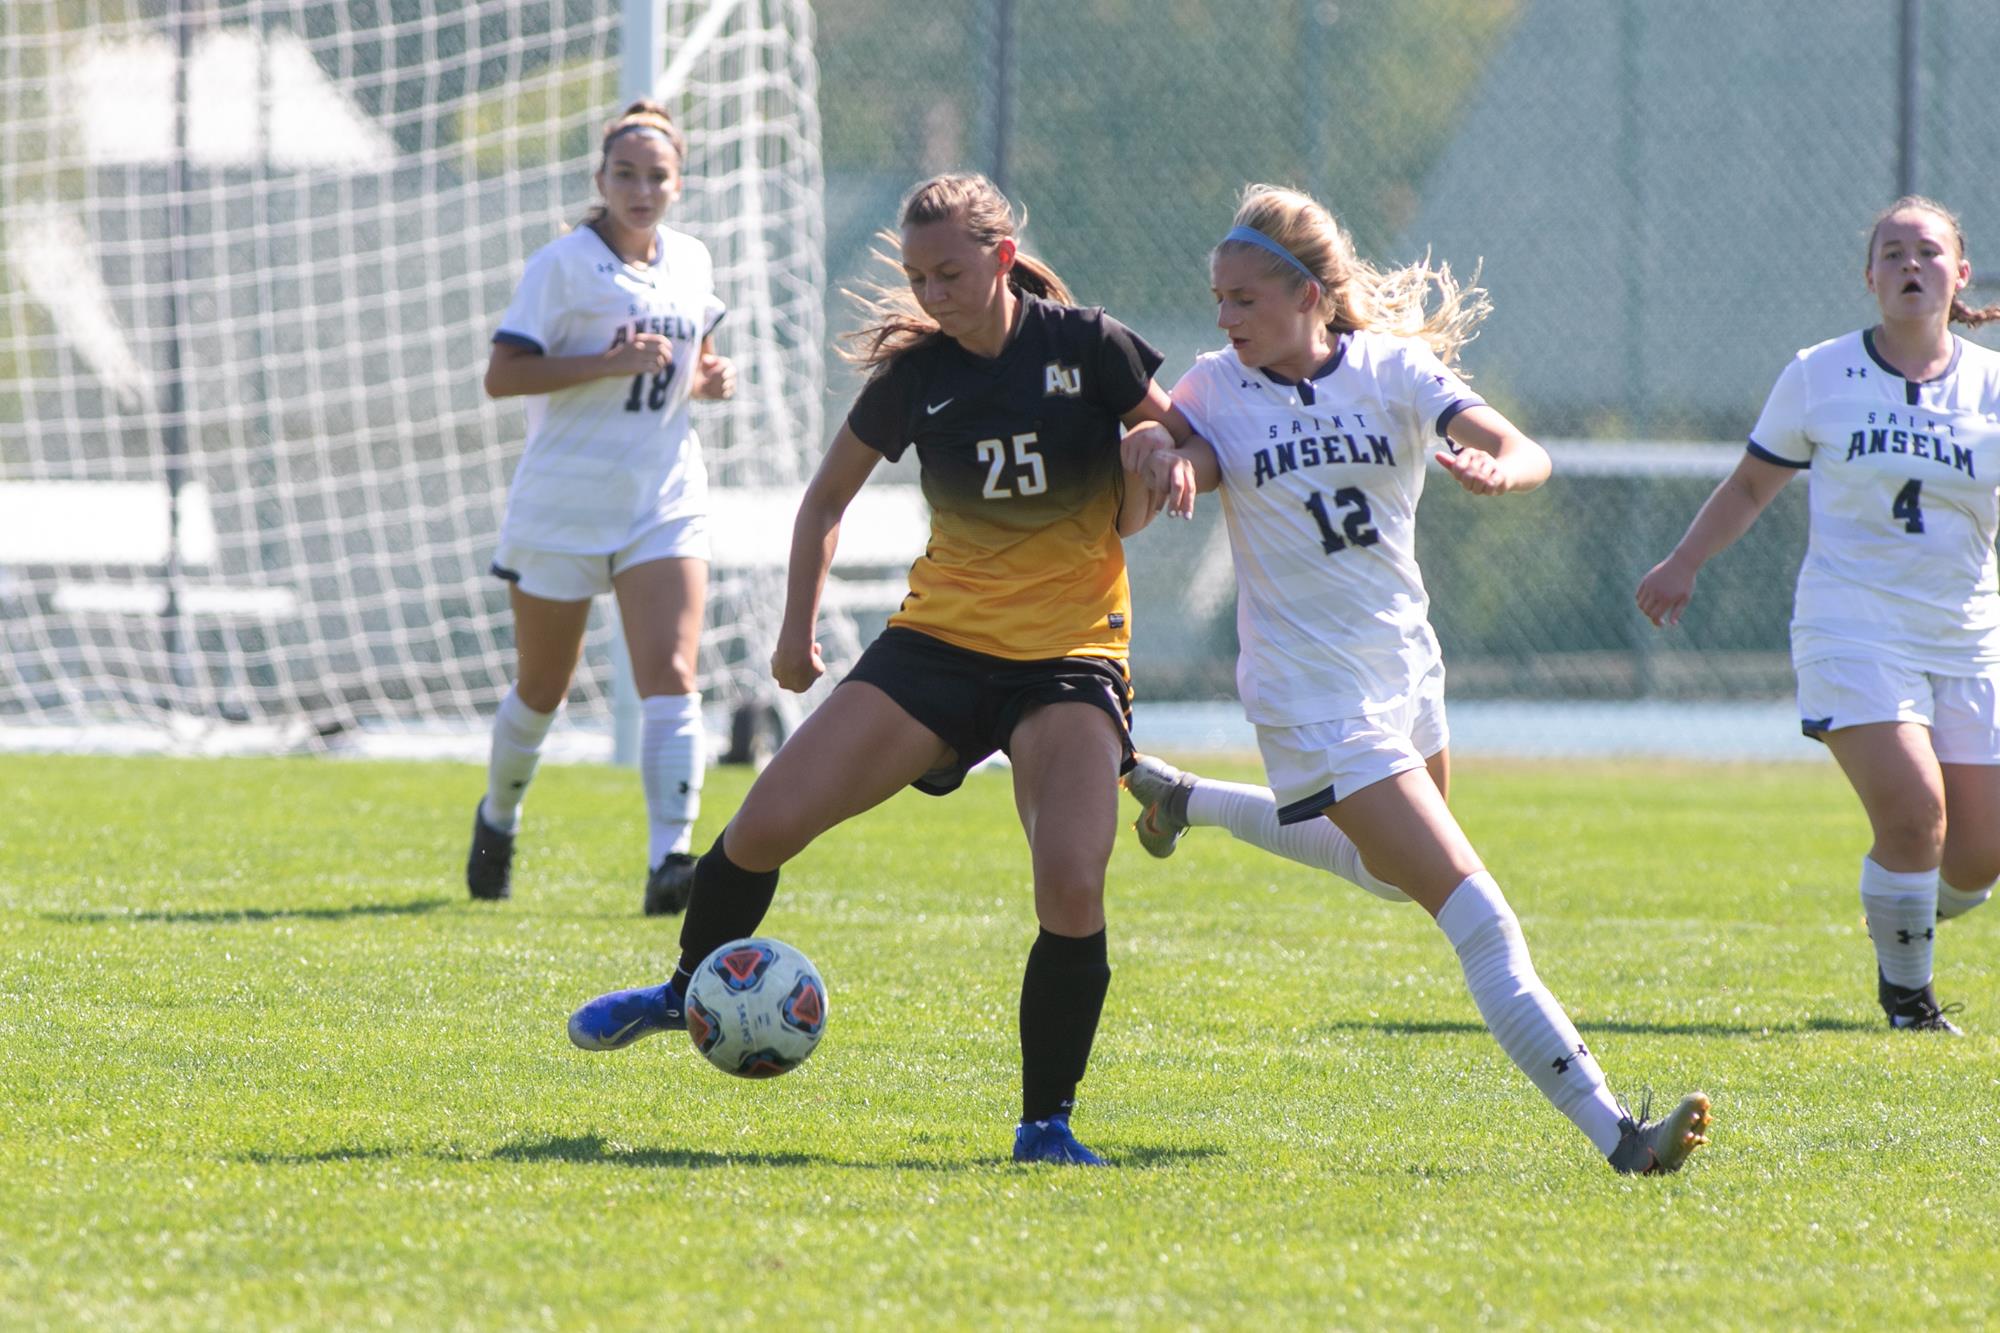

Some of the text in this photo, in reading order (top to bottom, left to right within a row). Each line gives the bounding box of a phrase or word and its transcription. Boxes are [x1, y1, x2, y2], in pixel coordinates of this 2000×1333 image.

[625, 362, 676, 412] 18
[1045, 362, 1082, 395] AU
[1268, 413, 1367, 439] SAINT
[1867, 411, 1955, 438] SAINT
[976, 432, 1047, 499] 25
[1253, 433, 1397, 488] ANSELM
[1845, 428, 1976, 480] ANSELM
[1303, 486, 1380, 556] 12
[1891, 478, 1926, 534] 4
